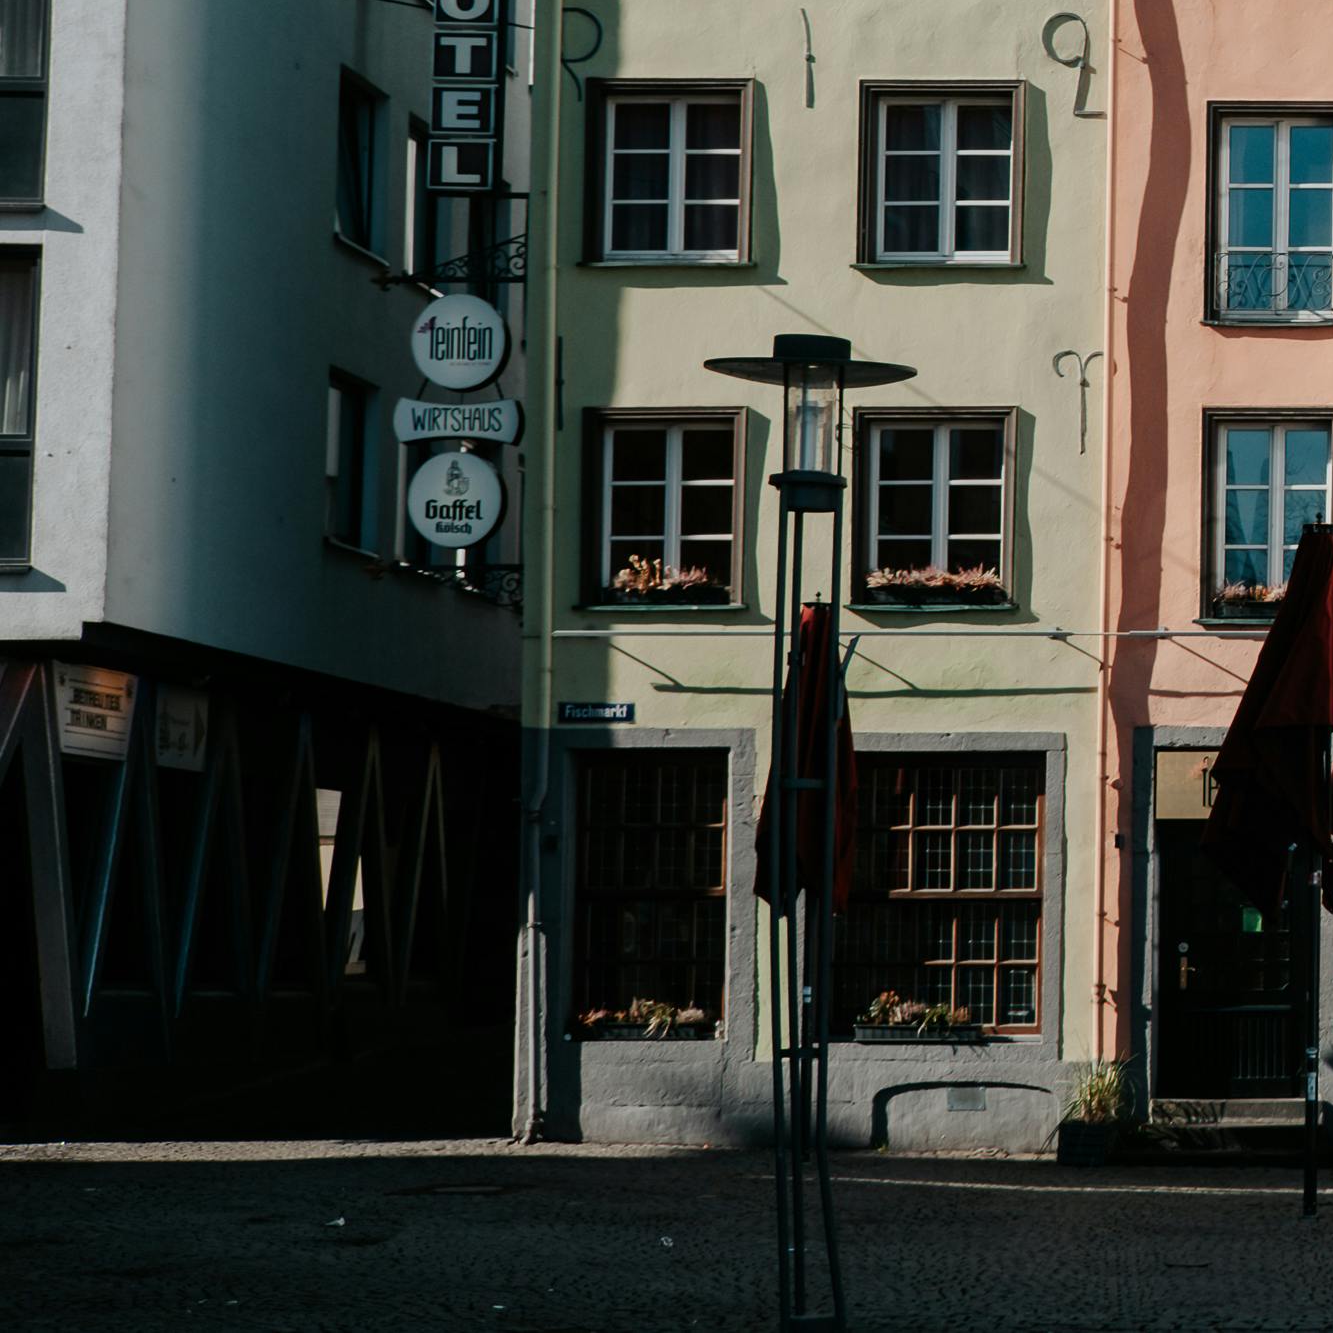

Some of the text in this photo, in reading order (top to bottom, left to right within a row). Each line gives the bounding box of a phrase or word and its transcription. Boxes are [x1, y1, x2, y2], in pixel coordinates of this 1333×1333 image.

[429, 315, 493, 361] feinfein
[411, 407, 503, 433] WIRTSHAUS
[425, 499, 483, 521] Gaffel
[564, 704, 628, 718] Fischmarkt
